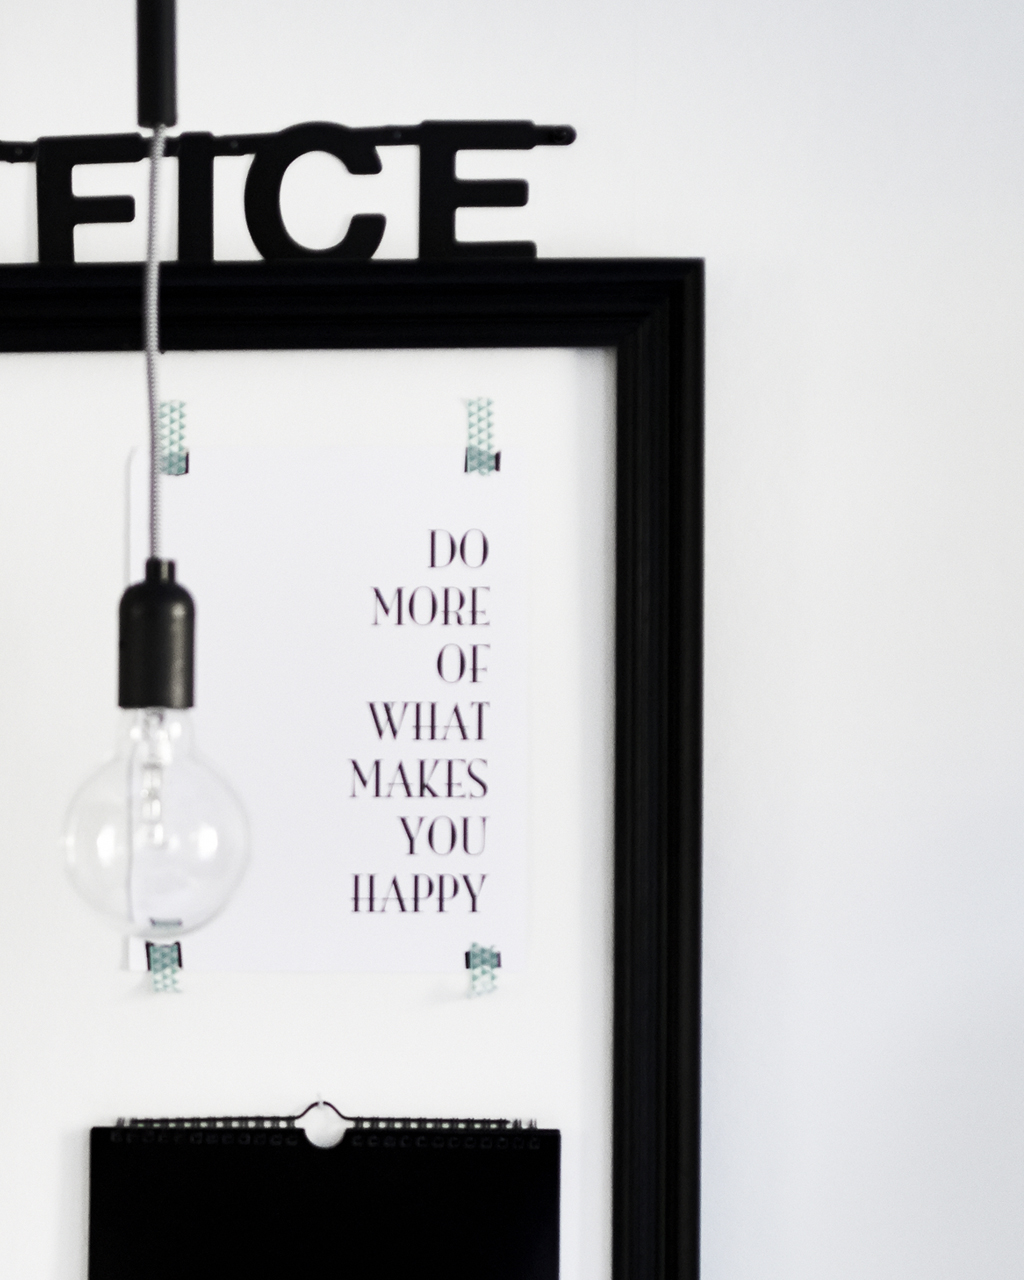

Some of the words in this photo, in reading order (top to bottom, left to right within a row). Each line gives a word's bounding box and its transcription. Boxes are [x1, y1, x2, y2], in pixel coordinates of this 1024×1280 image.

[427, 529, 490, 569] DO
[371, 586, 491, 627] MORE
[436, 643, 491, 684] OF
[367, 701, 491, 742] WHAT
[349, 758, 489, 800] MAKES
[398, 815, 487, 856] YOU
[350, 873, 487, 914] HAPPY
